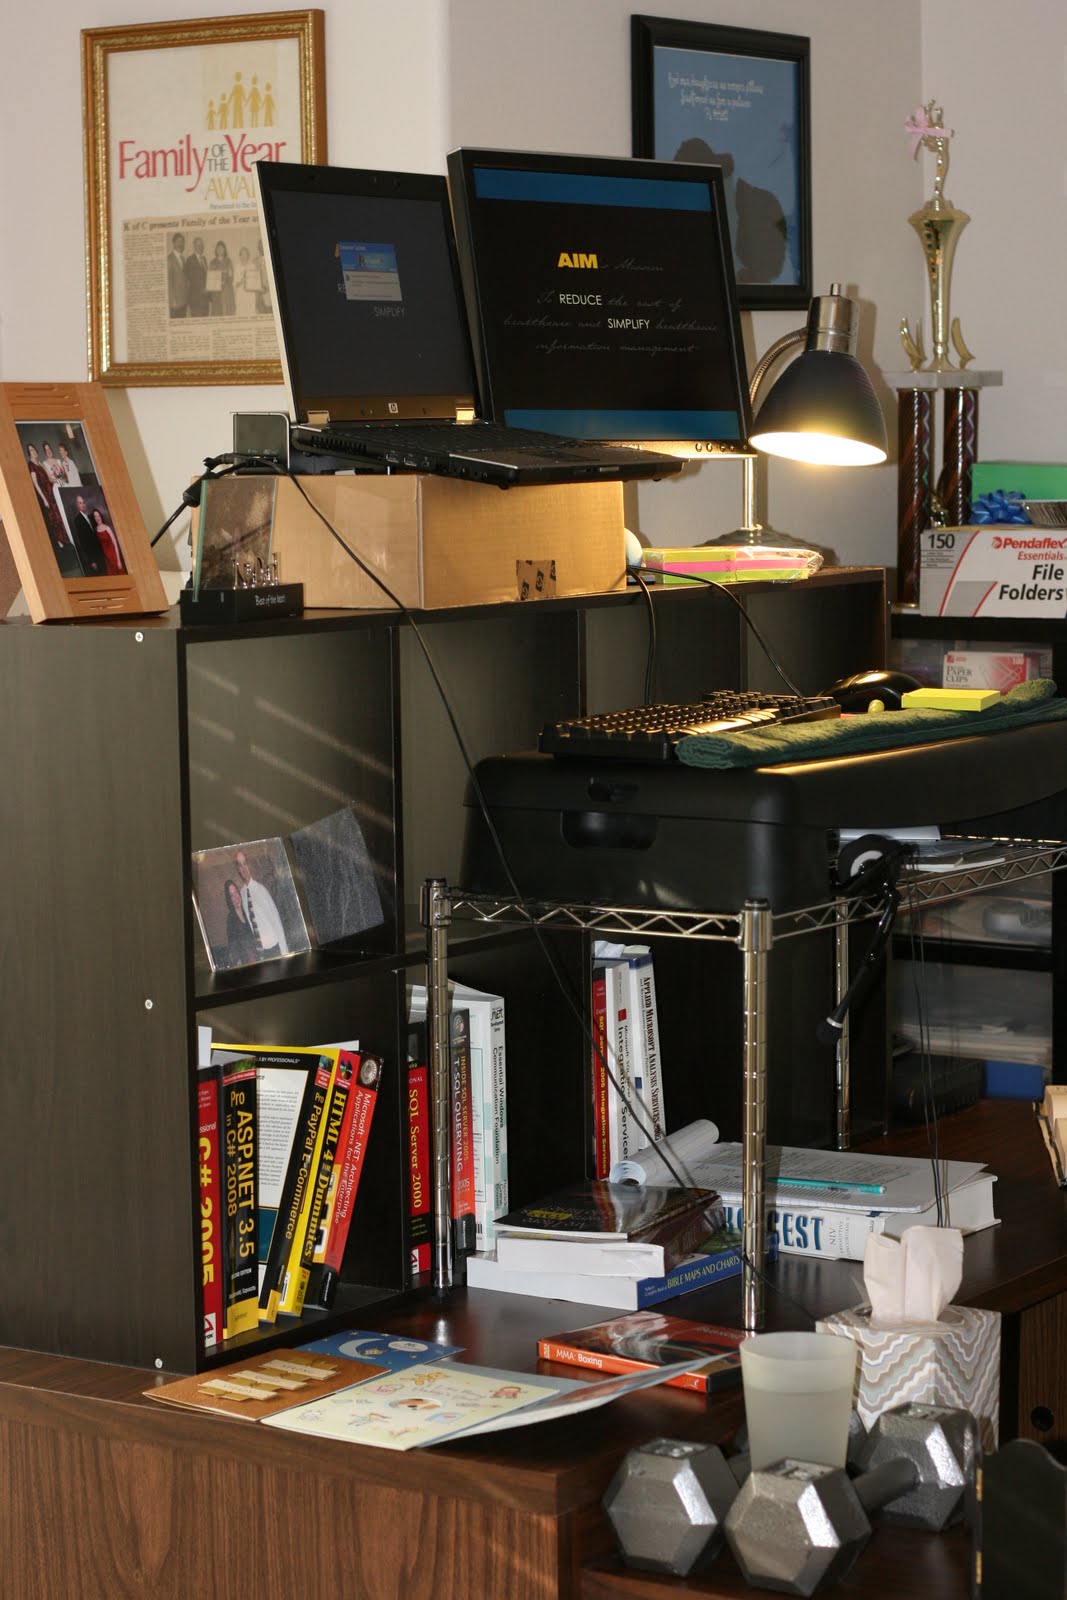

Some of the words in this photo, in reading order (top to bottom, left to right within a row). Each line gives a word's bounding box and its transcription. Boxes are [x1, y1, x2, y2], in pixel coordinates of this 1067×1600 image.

[119, 134, 209, 192] Family
[207, 158, 230, 172] THE
[211, 144, 227, 158] OF
[204, 175, 256, 200] AWA
[181, 217, 206, 228] Family
[208, 215, 217, 224] of
[218, 215, 231, 224] the
[233, 214, 250, 224] Year
[557, 252, 599, 269] AIM
[559, 293, 603, 306] REDUCE
[607, 318, 651, 330] SIMPLIFY
[928, 533, 955, 549] 150
[1003, 537, 1067, 549] Pendaflex
[1017, 550, 1064, 560] Essentials
[1032, 563, 1064, 580] File
[998, 583, 1064, 601] Folders
[947, 665, 972, 676] PAPER
[643, 977, 652, 1008] APPLIED
[646, 1008, 655, 1051] MICROSOFT
[649, 1053, 657, 1088] ANALYSIS
[230, 1090, 245, 1108] Pro
[409, 1089, 419, 1123] SQL
[651, 1088, 660, 1123] SERVICES
[226, 1114, 233, 1128] in
[305, 1105, 322, 1149] PayPal
[326, 1091, 348, 1145] HTML
[348, 1091, 364, 1145] Applications
[226, 1129, 237, 1157] C#
[410, 1125, 420, 1168] Server
[455, 1101, 463, 1173] QUERYING
[237, 1110, 255, 1210] ASP.NET
[323, 1149, 334, 1161] 4
[346, 1147, 354, 1159] for
[342, 1162, 350, 1177] the
[227, 1165, 238, 1217] 2008
[285, 1149, 313, 1240] E-Commerce
[334, 1177, 348, 1224] Enterprise
[340, 1164, 358, 1219] Architecting
[412, 1173, 423, 1208] 2000
[304, 1174, 330, 1258] Dummies
[239, 1218, 255, 1258] 3.5
[667, 1275, 683, 1289] BIBLE
[685, 1270, 701, 1283] MAPS
[701, 1264, 716, 1277] AND
[716, 1255, 740, 1272] CHARTS
[577, 1353, 603, 1368] Boxing
